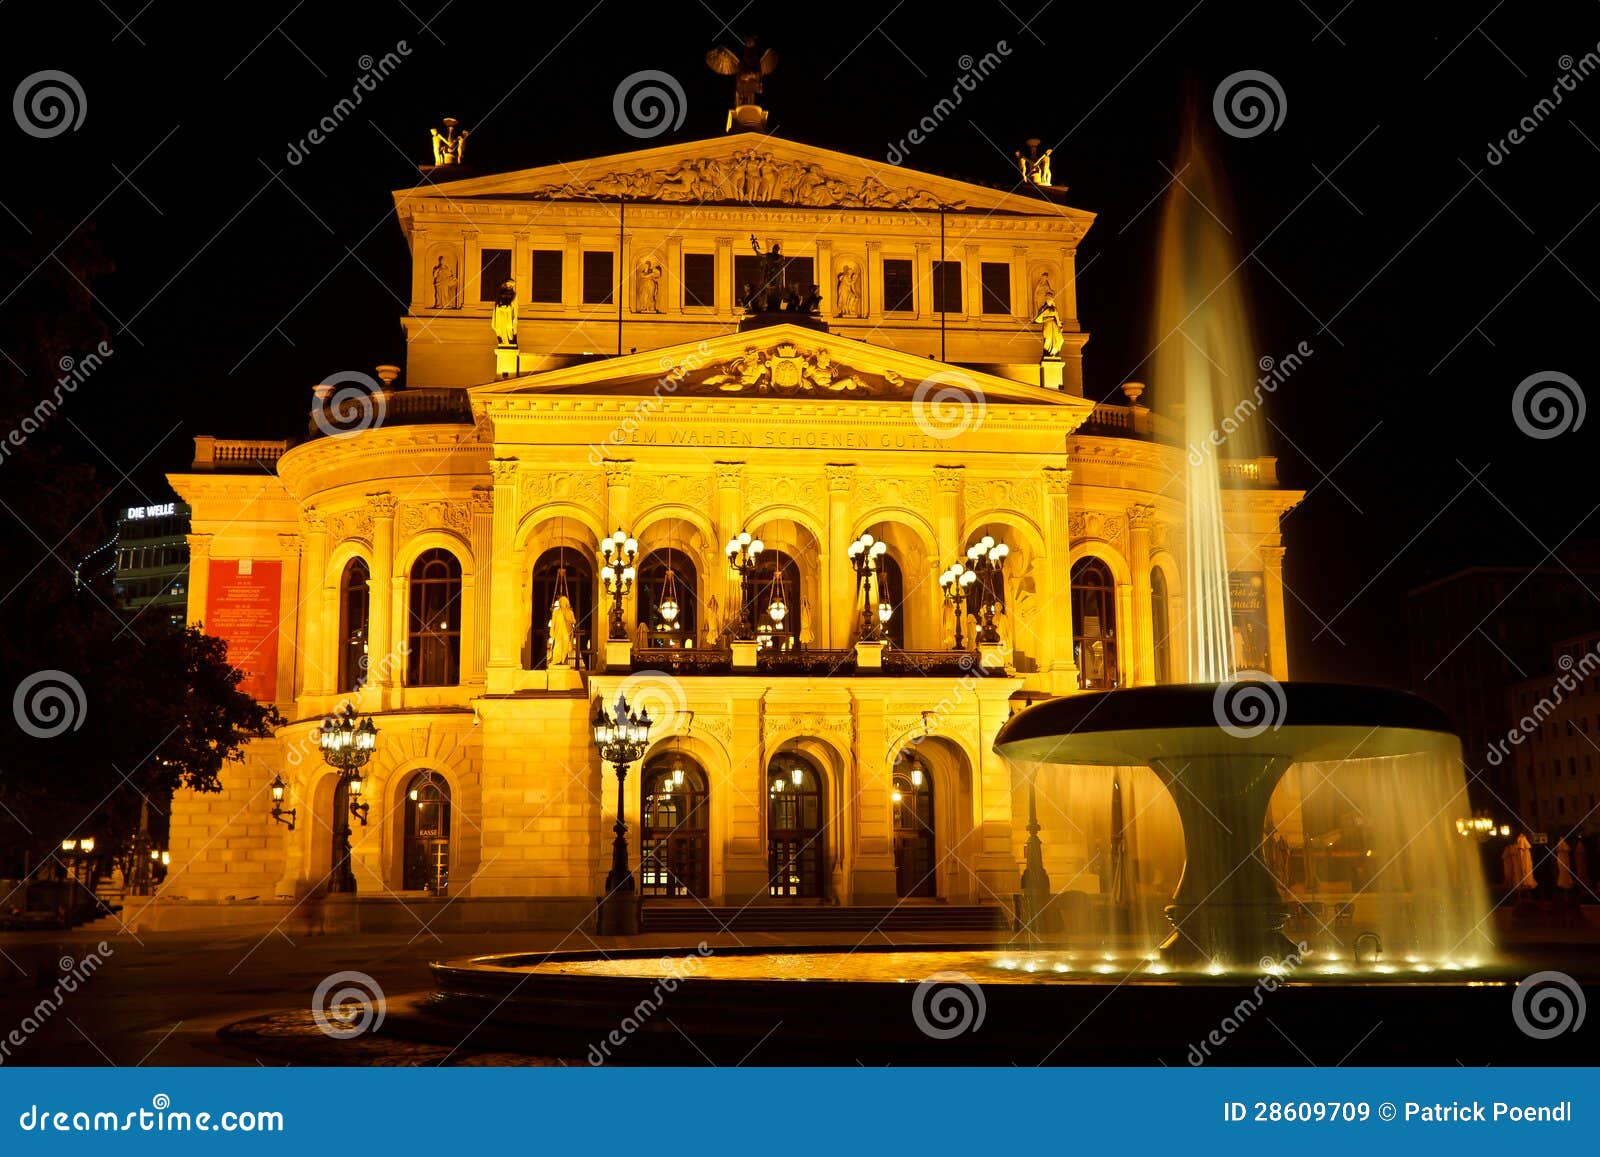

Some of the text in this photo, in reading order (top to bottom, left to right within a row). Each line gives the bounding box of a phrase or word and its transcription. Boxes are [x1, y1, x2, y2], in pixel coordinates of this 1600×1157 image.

[616, 428, 657, 443] DEM
[668, 430, 752, 445] WAHREN
[765, 431, 869, 447] SCHOENEN
[127, 502, 175, 520] DIE WELLE
